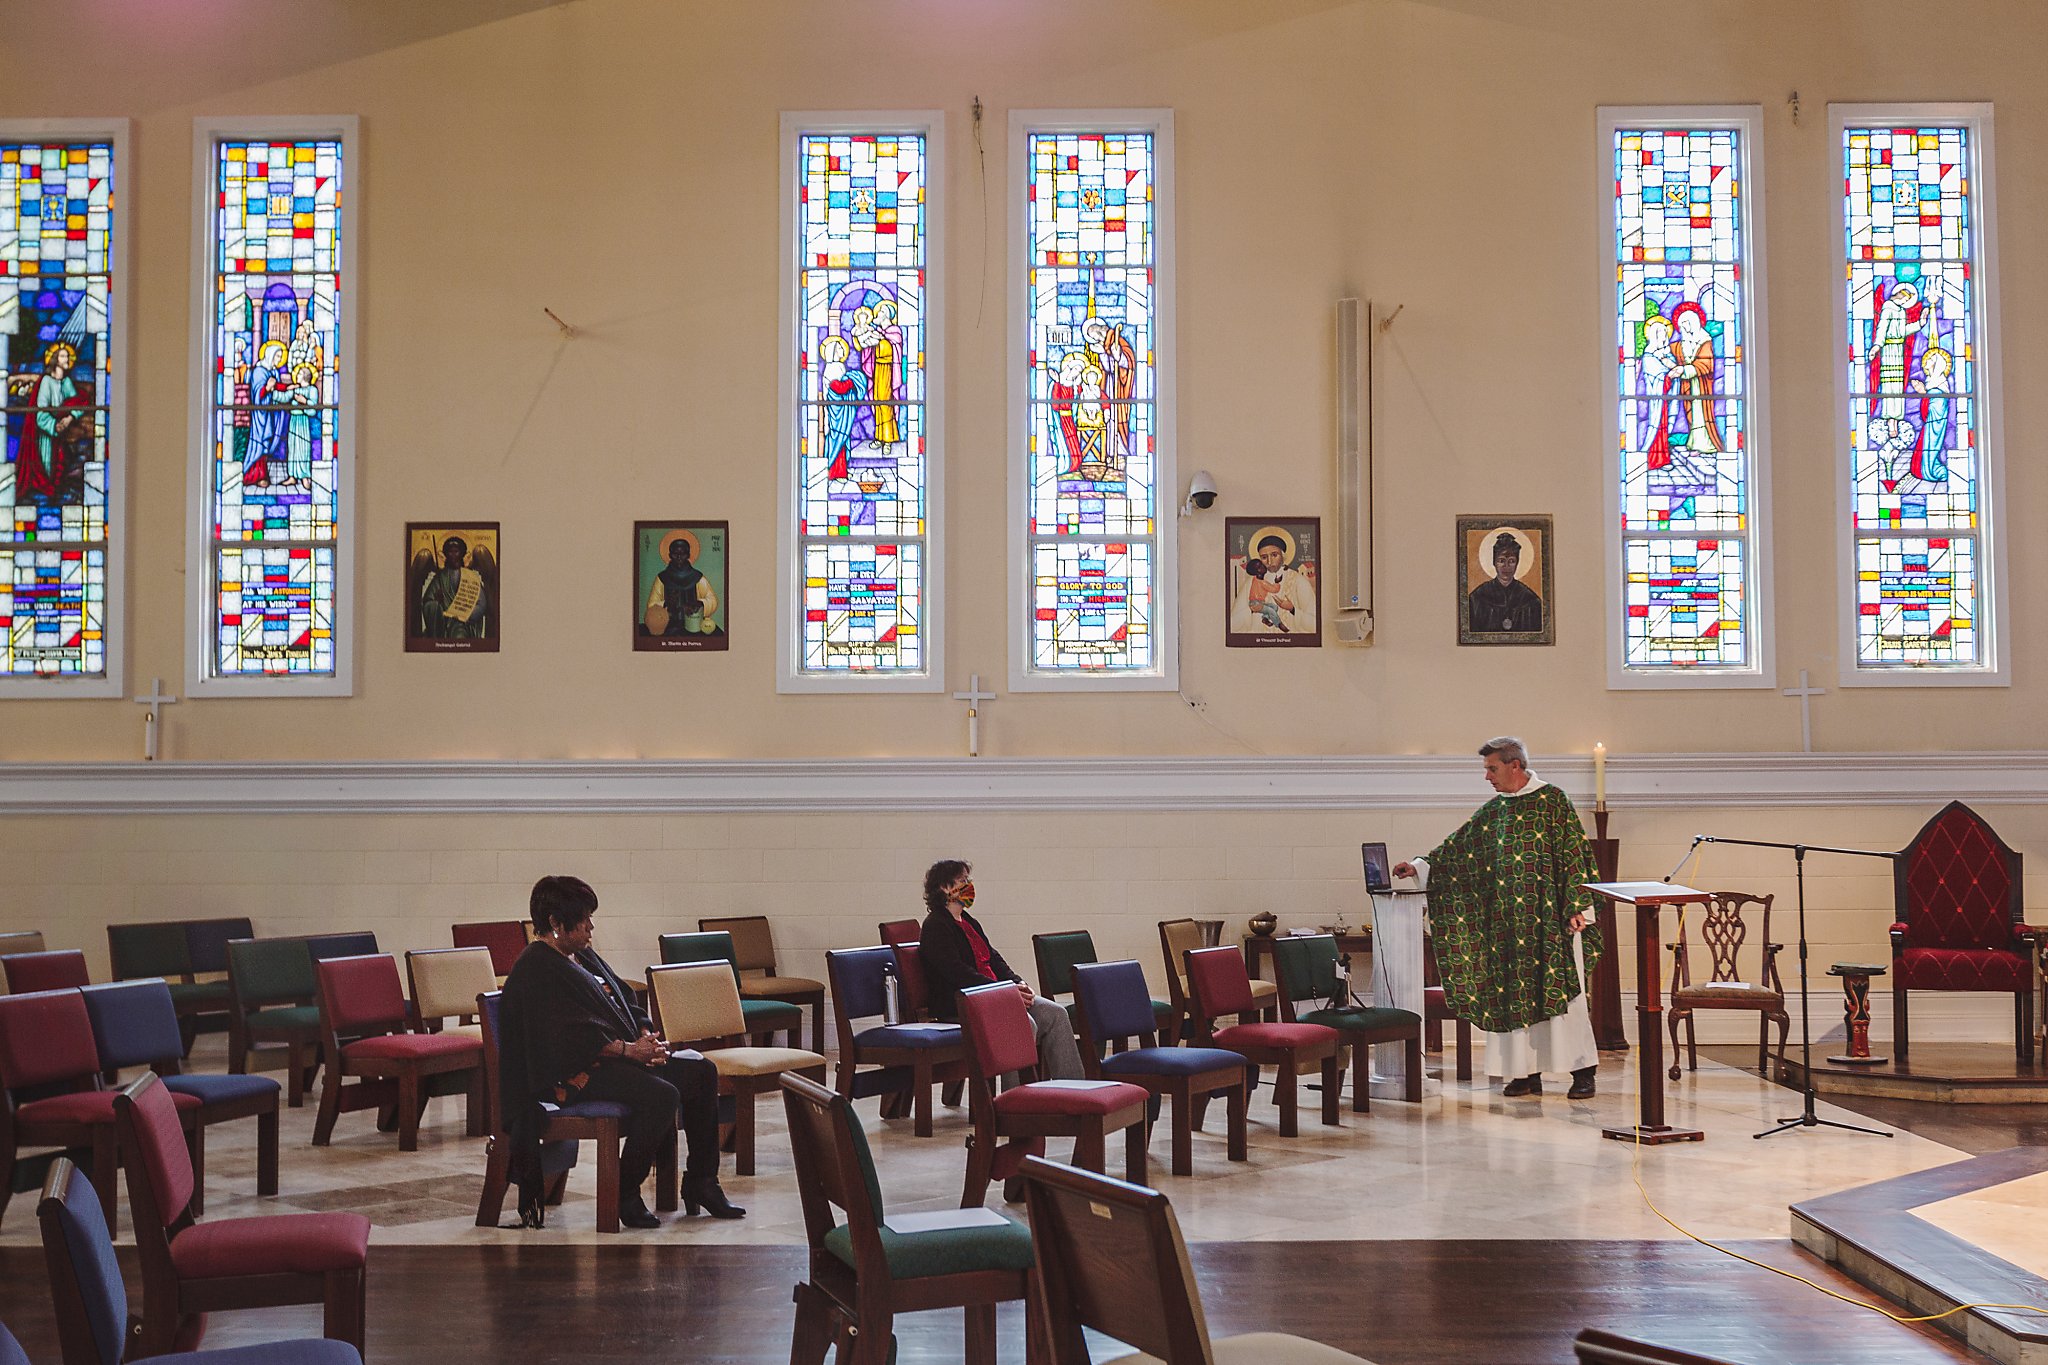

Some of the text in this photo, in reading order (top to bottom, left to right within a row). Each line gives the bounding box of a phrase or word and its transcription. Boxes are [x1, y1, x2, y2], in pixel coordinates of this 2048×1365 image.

[1059, 582, 1123, 590] GLORY TO GOD
[1060, 595, 1069, 603] IN
[1088, 595, 1123, 603] HIGHEST
[55, 602, 81, 610] DEATH
[242, 600, 297, 608] AT HIS WISDOM
